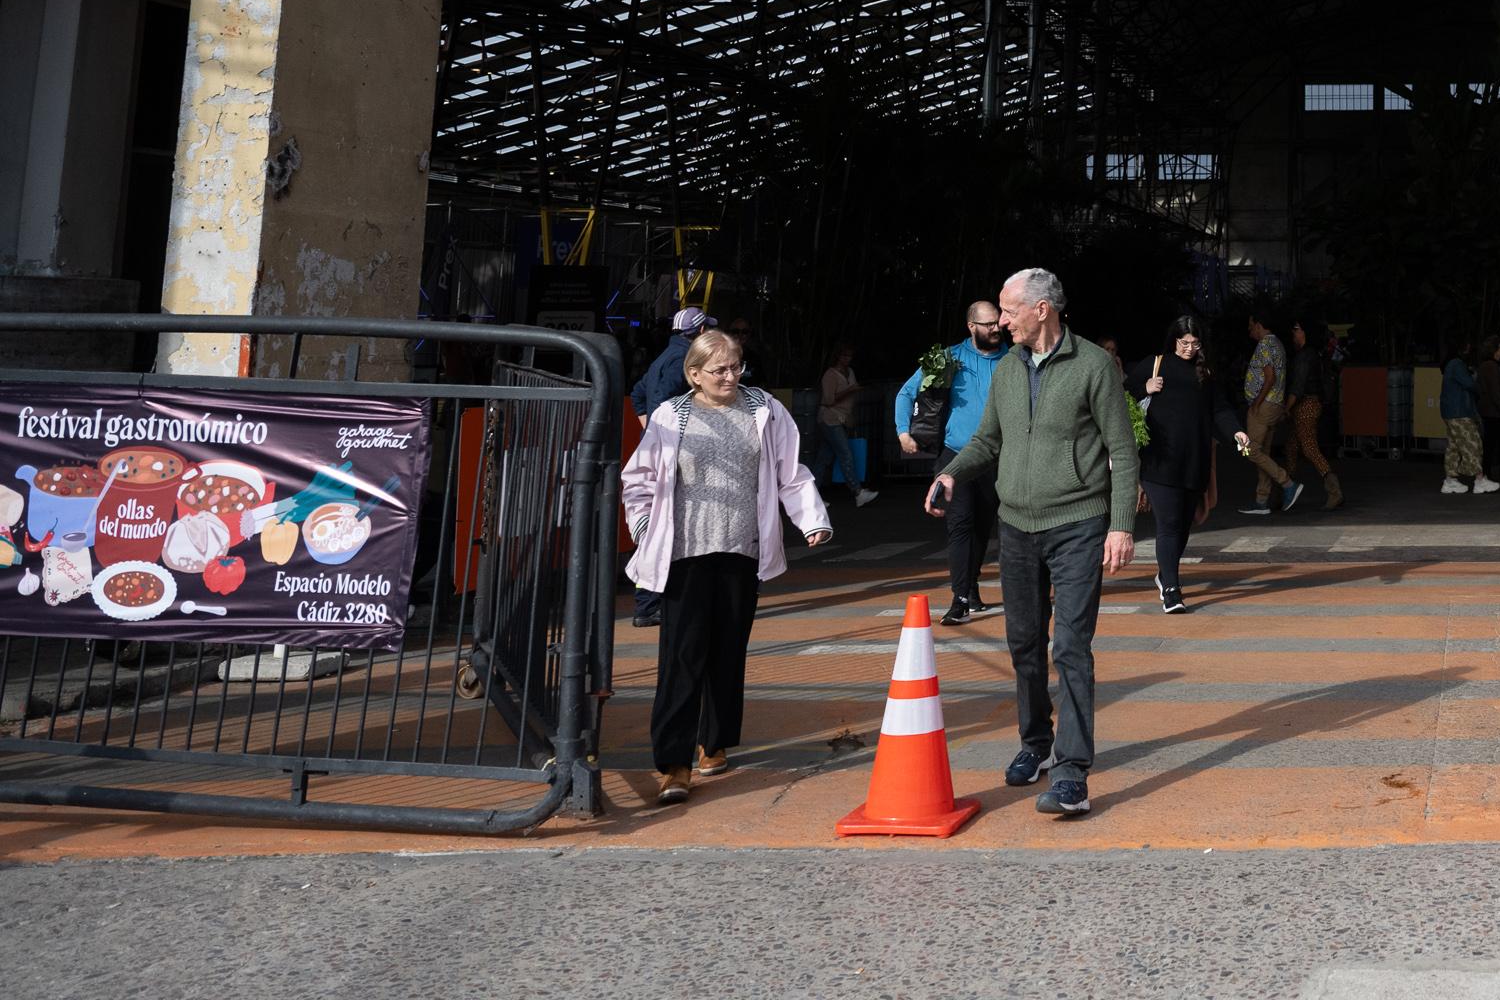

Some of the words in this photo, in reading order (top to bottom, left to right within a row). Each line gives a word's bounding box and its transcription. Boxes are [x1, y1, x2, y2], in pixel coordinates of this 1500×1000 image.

[438, 234, 460, 291] Prex
[17, 406, 103, 440] festival
[104, 412, 268, 447] gastronómico
[335, 423, 394, 449] garage
[341, 432, 413, 459] gourmet
[117, 498, 155, 520] ollas
[99, 516, 119, 537] del
[120, 518, 168, 540] mundo
[274, 570, 333, 598] Espacio
[334, 573, 392, 597] Modelo
[297, 600, 342, 623] Cádiz
[343, 602, 388, 625] 3280
